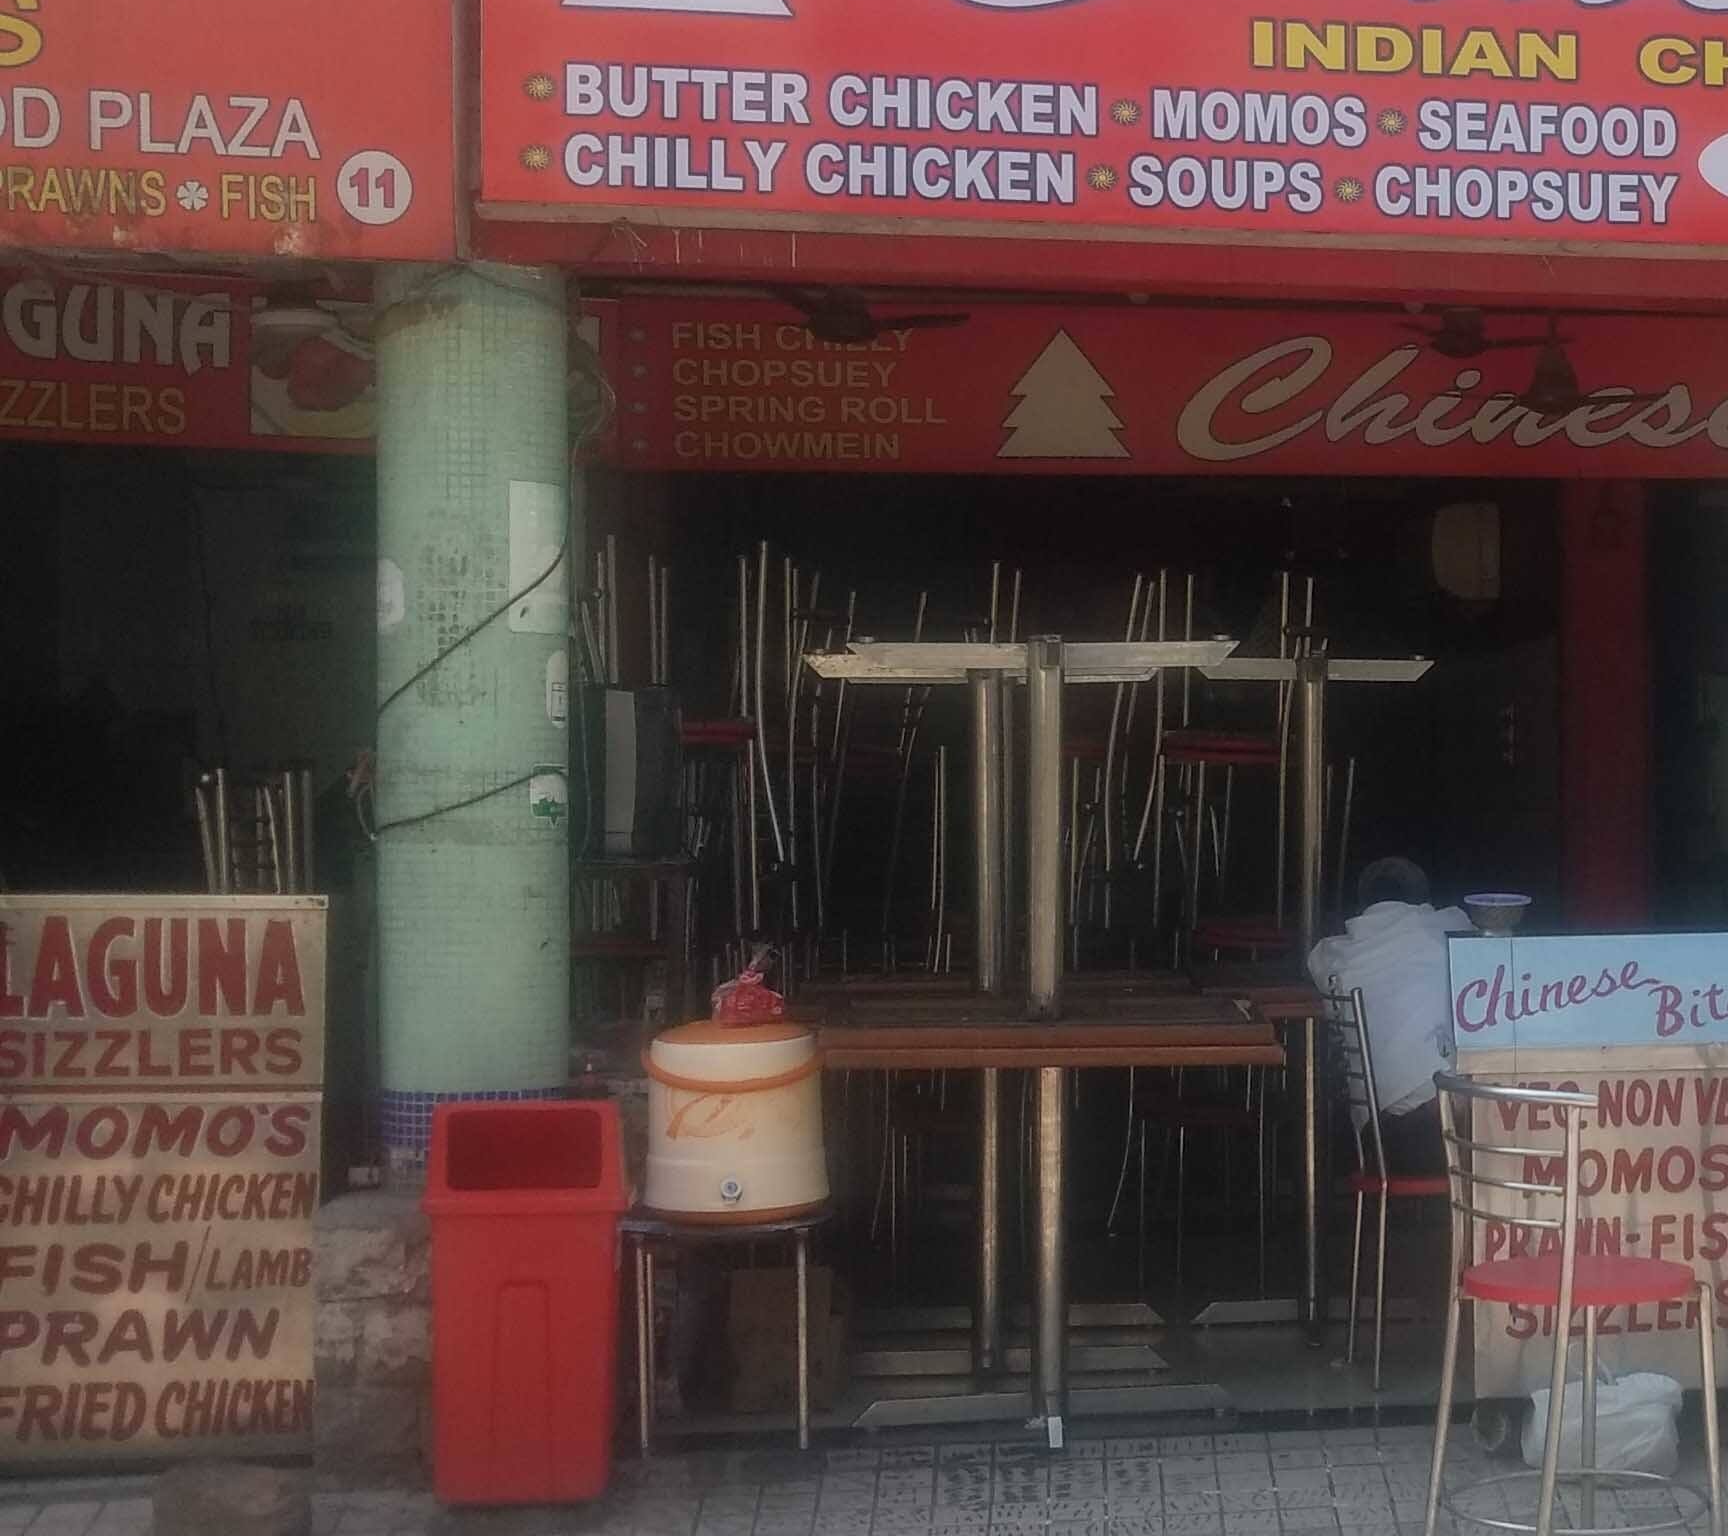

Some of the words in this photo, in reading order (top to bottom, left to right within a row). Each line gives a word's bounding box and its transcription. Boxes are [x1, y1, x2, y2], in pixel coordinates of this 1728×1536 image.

[1251, 19, 1578, 80] INDIAN
[89, 88, 321, 160] PLAZA
[565, 63, 811, 125] BUTTER
[828, 74, 1098, 136] CHICKEN
[1152, 88, 1367, 148] MOMOS
[1418, 99, 1678, 158] SEAFOOD
[220, 173, 316, 223] FISH
[349, 167, 396, 208] 11
[564, 133, 787, 193] CHILLY
[805, 142, 1075, 204] CHICKEN
[1128, 155, 1323, 213] SOUPS
[1374, 166, 1679, 224] CHOPSUEY
[671, 321, 762, 351] FISH
[671, 357, 898, 388] CHOPSUEY
[671, 394, 826, 424] SPRING
[839, 395, 948, 425] ROLL
[672, 430, 901, 461] CHOWMEIN
[0, 916, 306, 1019] LAGUNA
[1455, 960, 1662, 1033] Chinese
[0, 1027, 303, 1078] SIZZLERS
[1597, 1077, 1686, 1128] NON
[0, 1104, 313, 1160] MOMO'S
[146, 1171, 318, 1225] CHICKEN
[0, 1307, 280, 1366] PRAWN
[154, 1377, 315, 1440] CHICKEN
